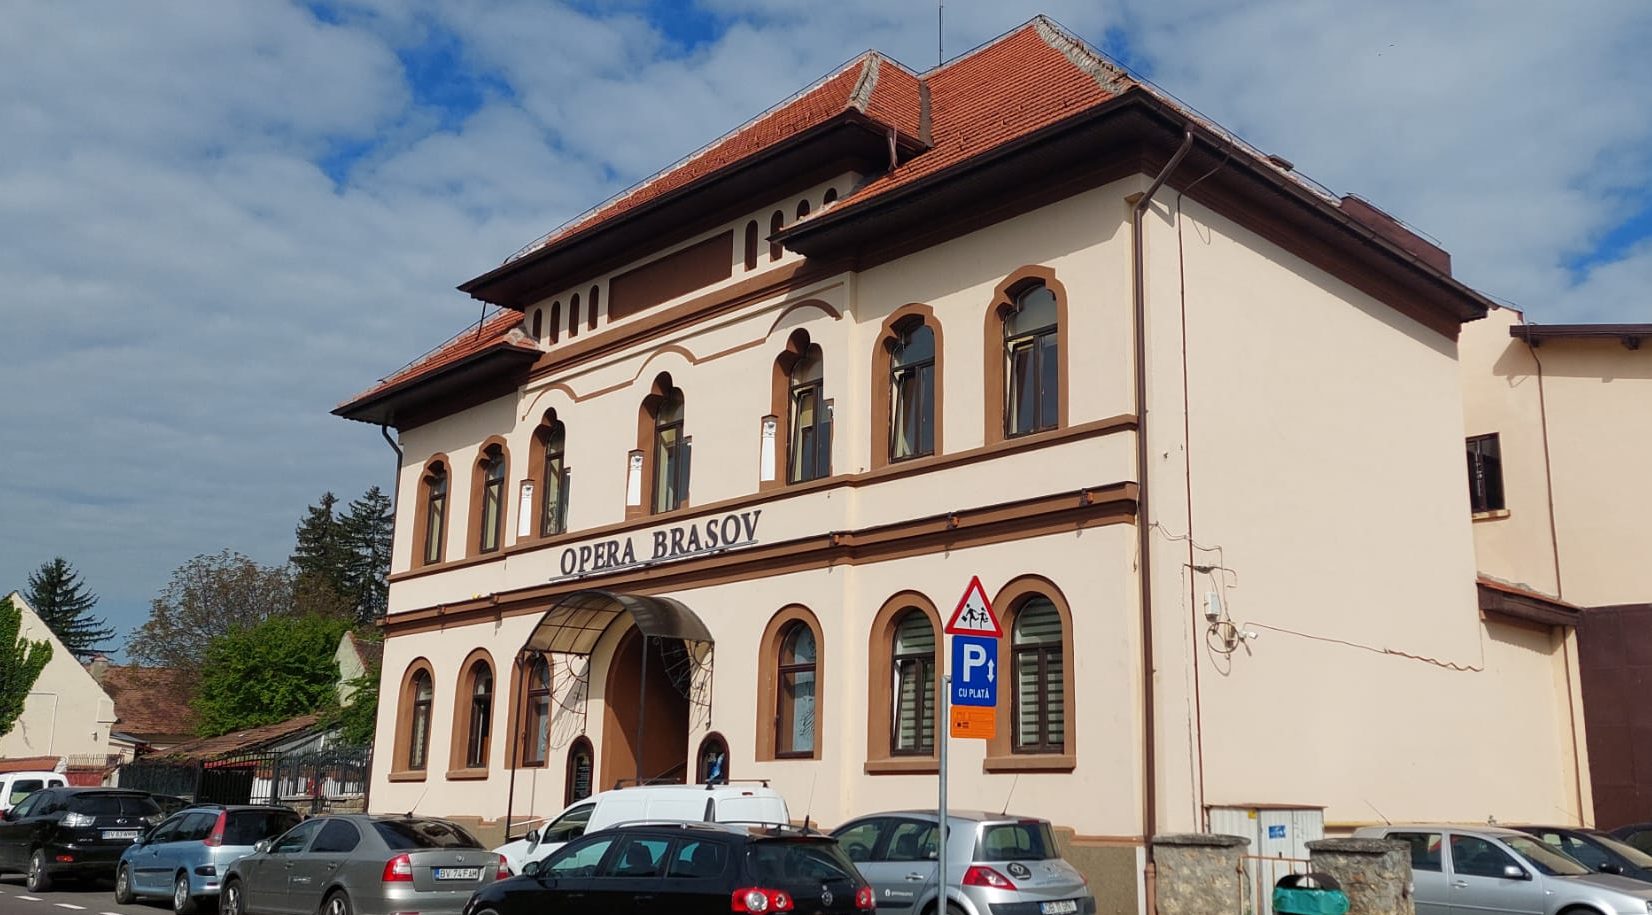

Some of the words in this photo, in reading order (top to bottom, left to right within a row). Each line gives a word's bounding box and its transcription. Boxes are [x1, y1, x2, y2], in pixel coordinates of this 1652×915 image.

[560, 537, 636, 575] OPERA
[652, 510, 762, 559] BRASOV
[963, 644, 987, 682] P
[959, 688, 967, 697] CU
[969, 687, 990, 699] PLATĂ
